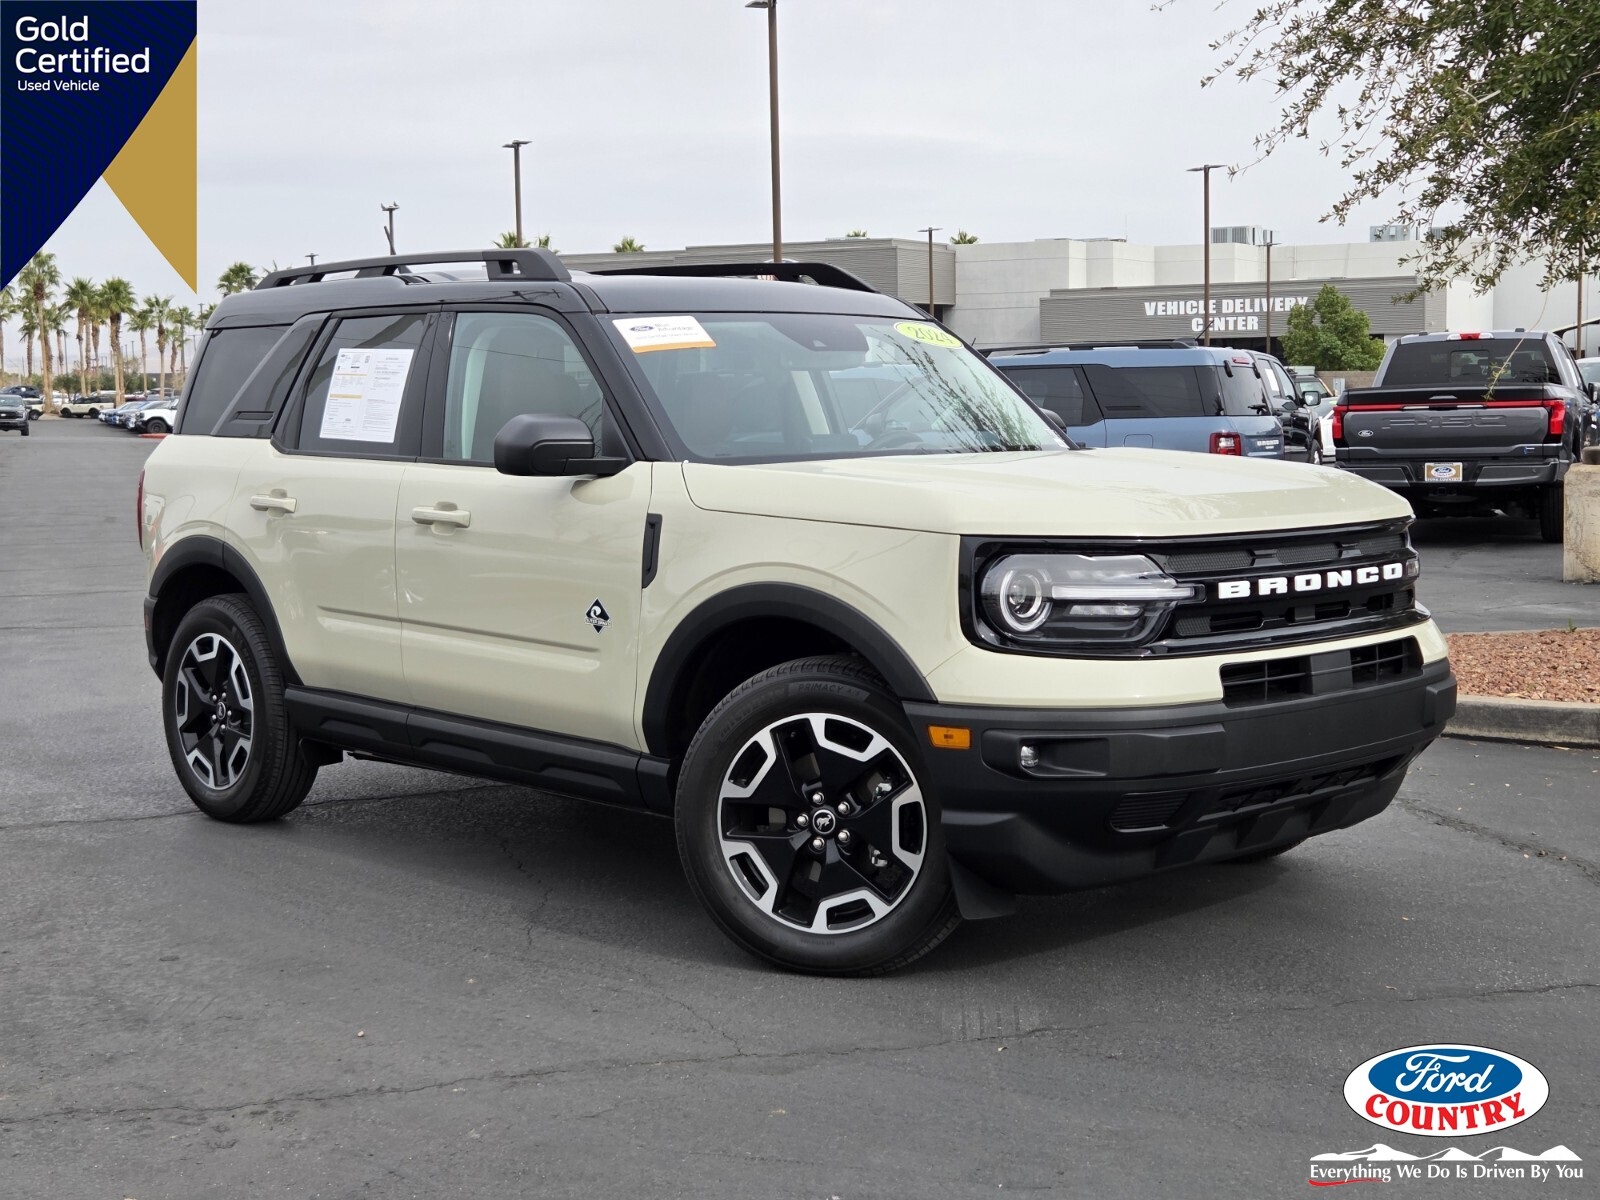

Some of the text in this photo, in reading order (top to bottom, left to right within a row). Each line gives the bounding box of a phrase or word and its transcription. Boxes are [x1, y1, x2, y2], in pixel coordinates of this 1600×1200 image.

[1144, 296, 1309, 316] VEHICLE DELIVERY
[1218, 562, 1403, 599] BRONCO
[798, 682, 844, 693] PRIMACY
